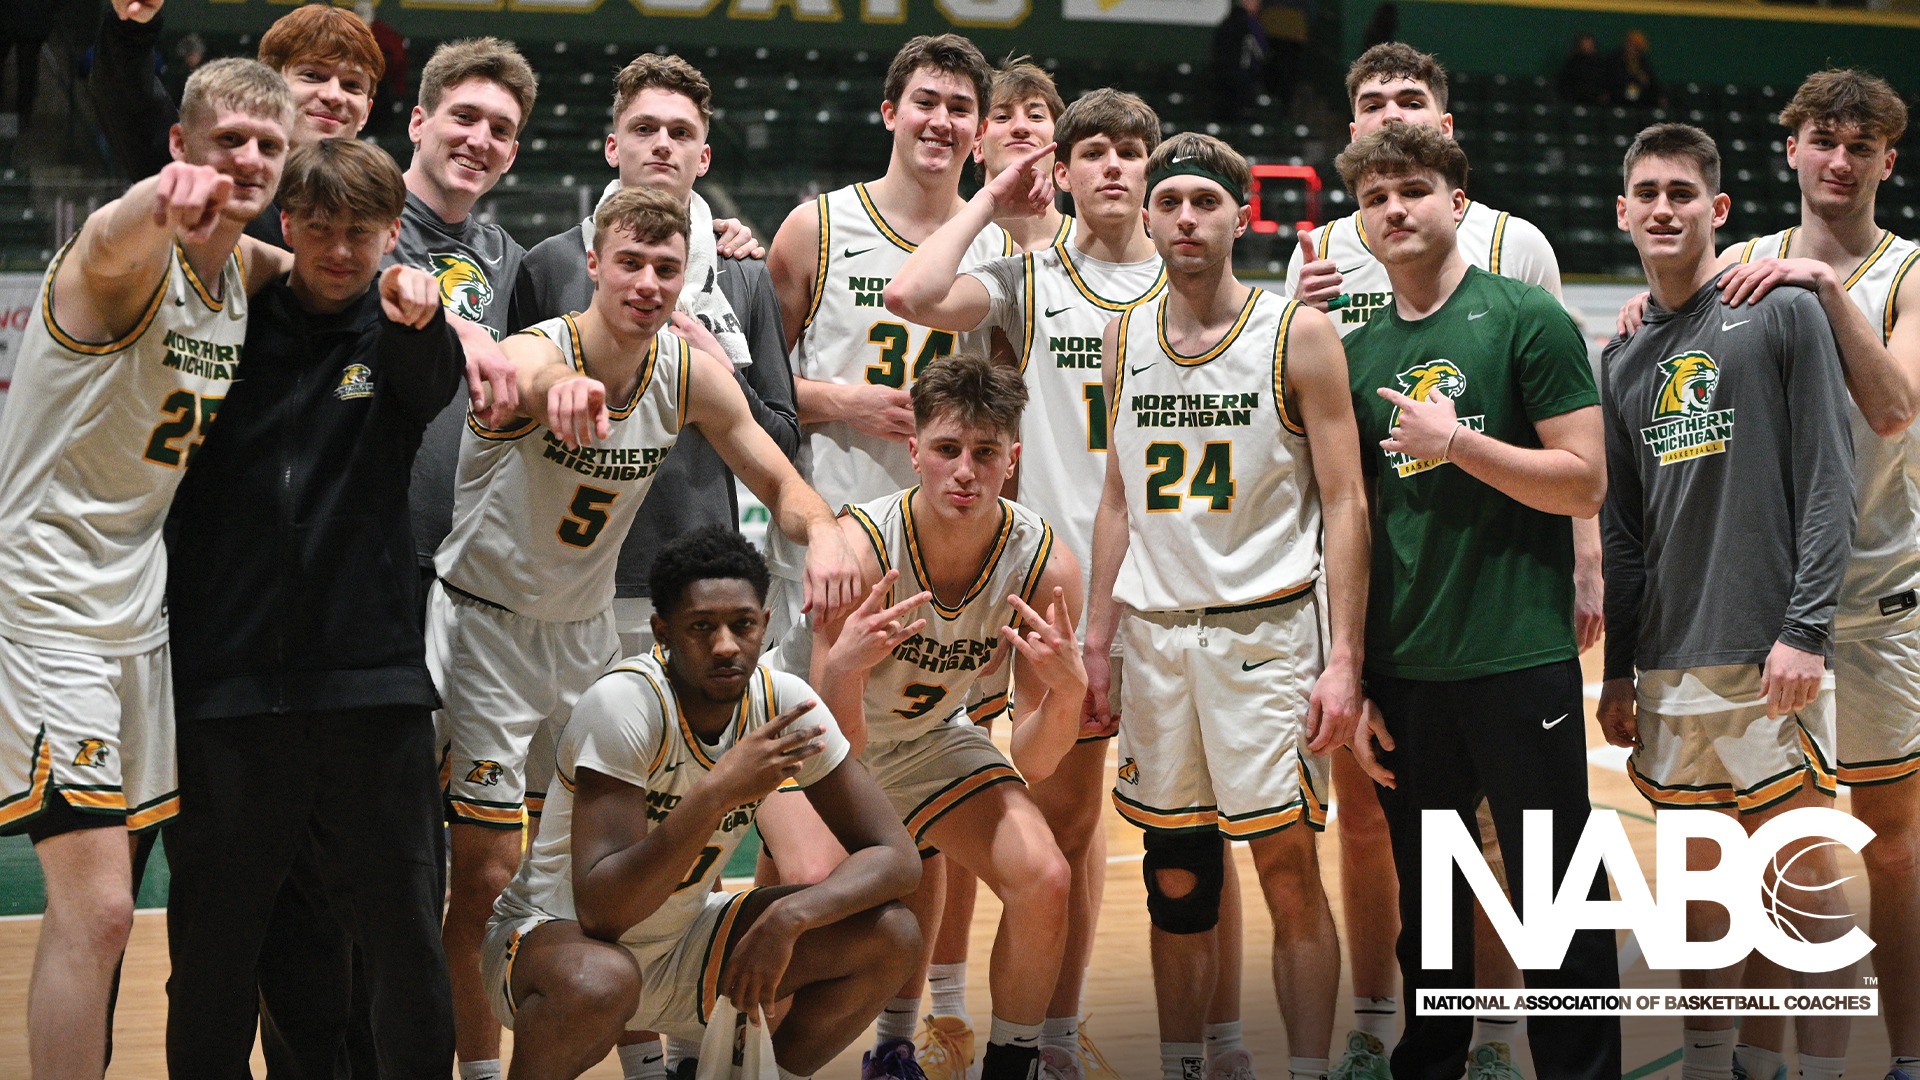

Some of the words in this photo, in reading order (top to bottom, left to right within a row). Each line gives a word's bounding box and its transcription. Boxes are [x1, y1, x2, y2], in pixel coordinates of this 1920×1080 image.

[864, 320, 958, 390] 34
[1131, 392, 1259, 411] NORTHERN
[1137, 409, 1251, 427] MICHIGAN
[1641, 409, 1734, 443] NORTHERN
[1652, 425, 1732, 455] MICHIGAN
[1145, 440, 1236, 513] 24
[556, 483, 620, 549] 5
[891, 681, 950, 720] 3
